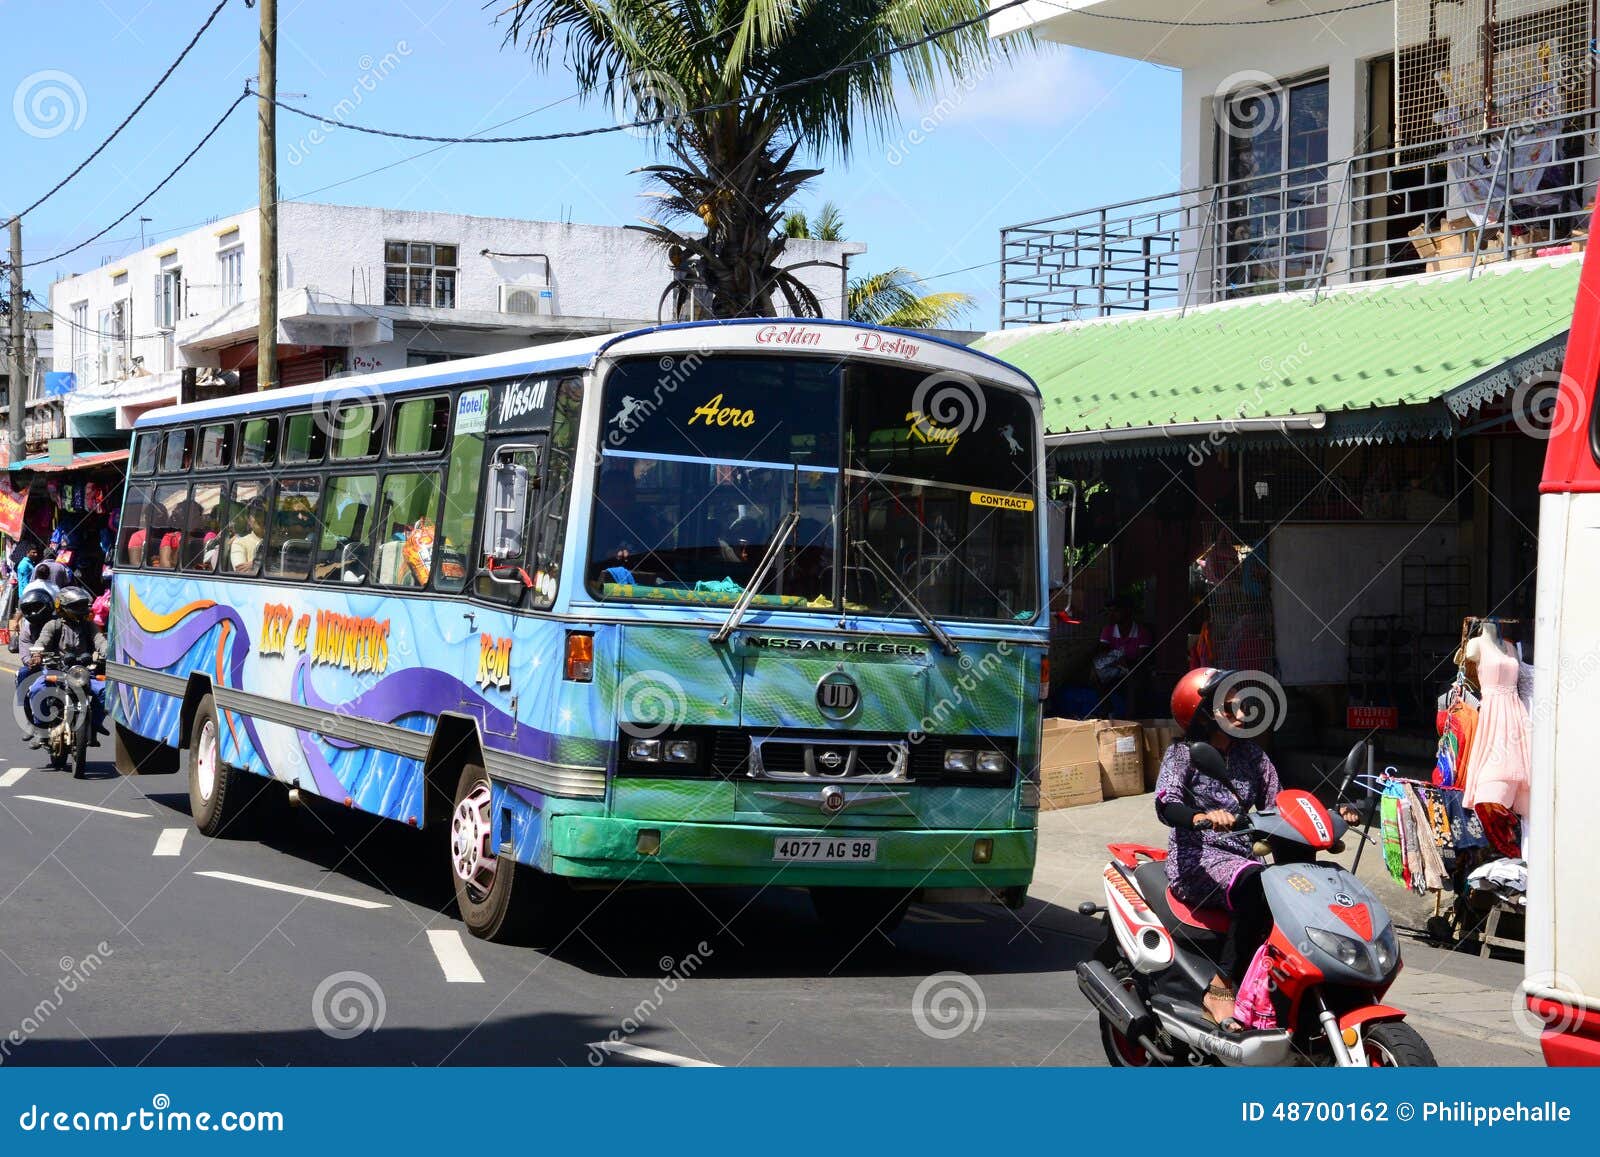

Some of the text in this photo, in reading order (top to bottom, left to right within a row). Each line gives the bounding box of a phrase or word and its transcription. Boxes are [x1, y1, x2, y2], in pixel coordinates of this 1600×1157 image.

[756, 326, 920, 359] Golden Destiny
[499, 380, 548, 424] Nissan
[688, 393, 959, 455] Aero King
[980, 495, 1028, 509] CONTRACT
[745, 636, 926, 656] NISSAN DIESEL
[823, 684, 854, 707] UD
[779, 841, 871, 858] 4077 AG 98
